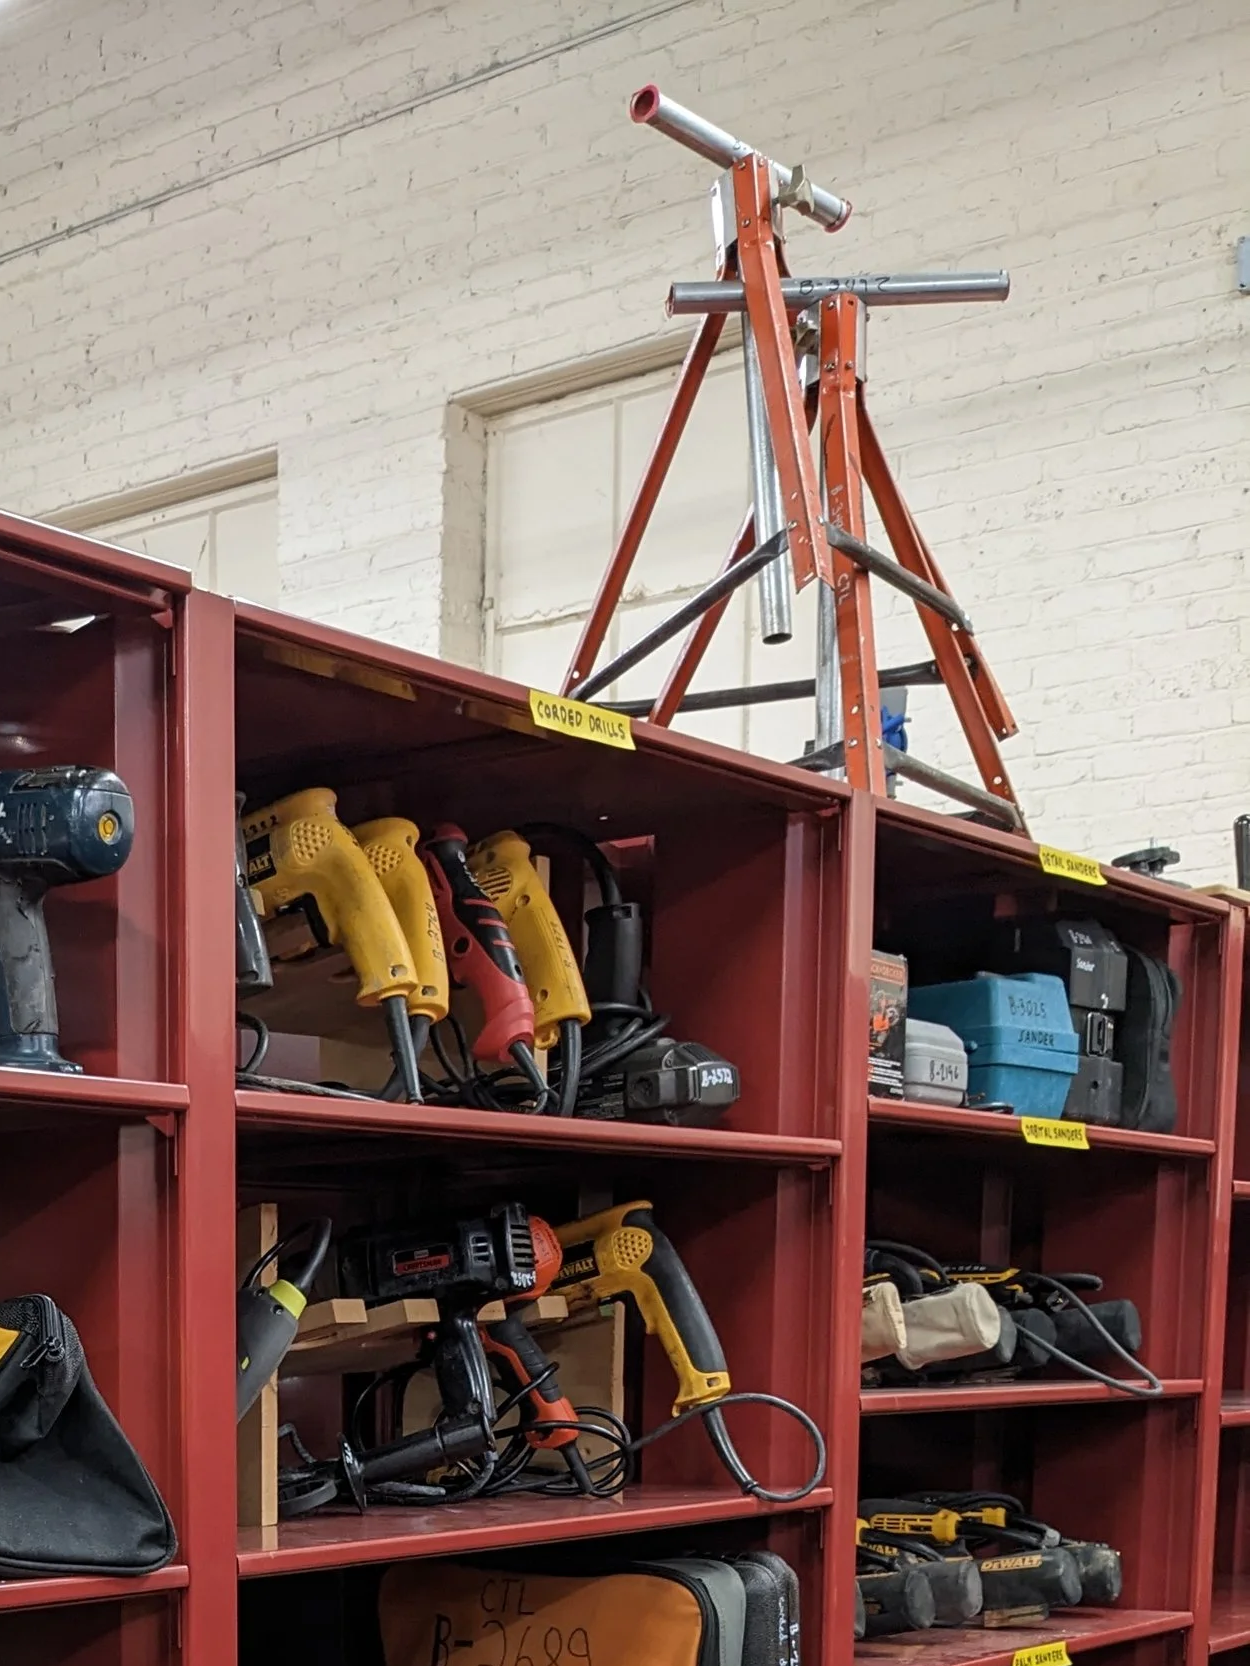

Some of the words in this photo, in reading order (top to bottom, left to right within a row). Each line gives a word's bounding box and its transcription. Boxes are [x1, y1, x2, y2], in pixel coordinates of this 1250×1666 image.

[537, 700, 582, 727] CORDED
[589, 714, 625, 740] DRILLS
[1066, 859, 1098, 879] SANDERS
[1018, 1029, 1055, 1046] SANDER
[1054, 1127, 1083, 1142] SANDERS
[982, 1555, 1041, 1570] DEWALT
[481, 1578, 535, 1615] CTL
[1035, 1649, 1064, 1665] SANDERS
